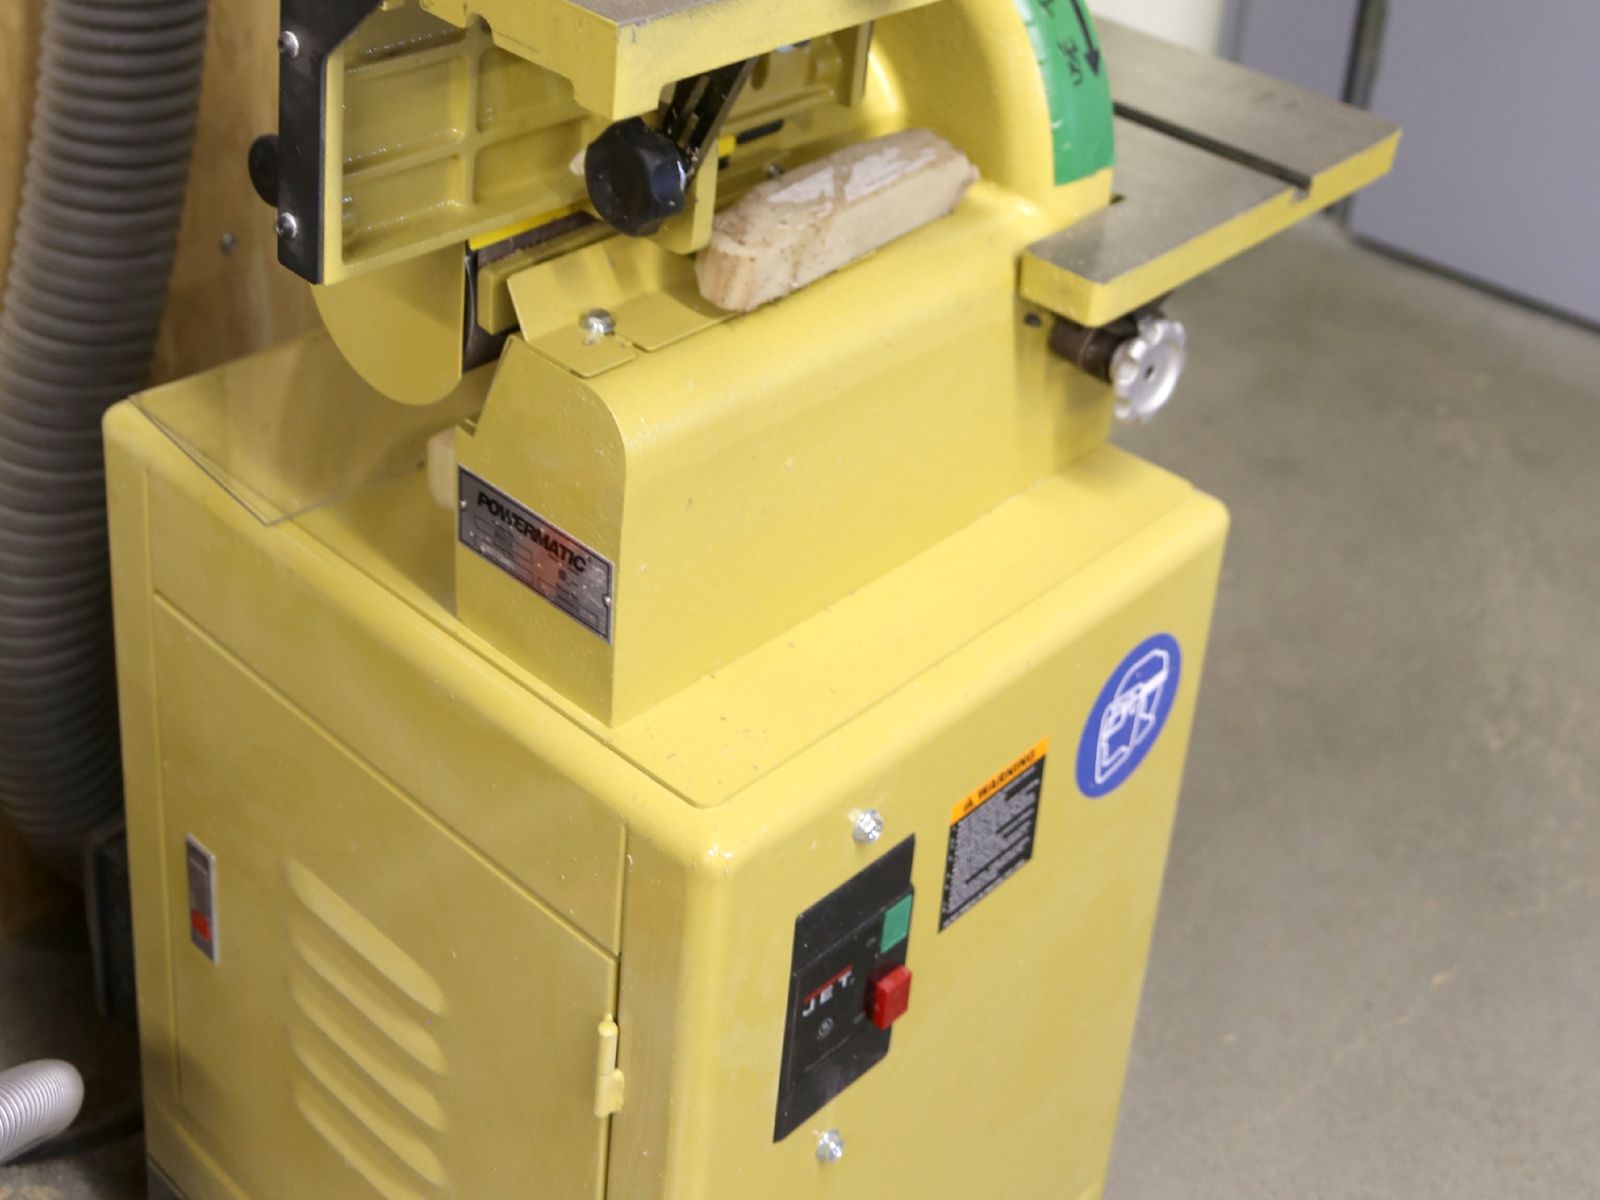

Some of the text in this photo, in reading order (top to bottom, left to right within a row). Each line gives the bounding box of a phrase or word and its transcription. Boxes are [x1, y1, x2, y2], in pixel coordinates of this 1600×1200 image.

[477, 490, 587, 573] POWERMATIC
[977, 748, 1036, 798] WARNING
[802, 969, 853, 1017] JET
